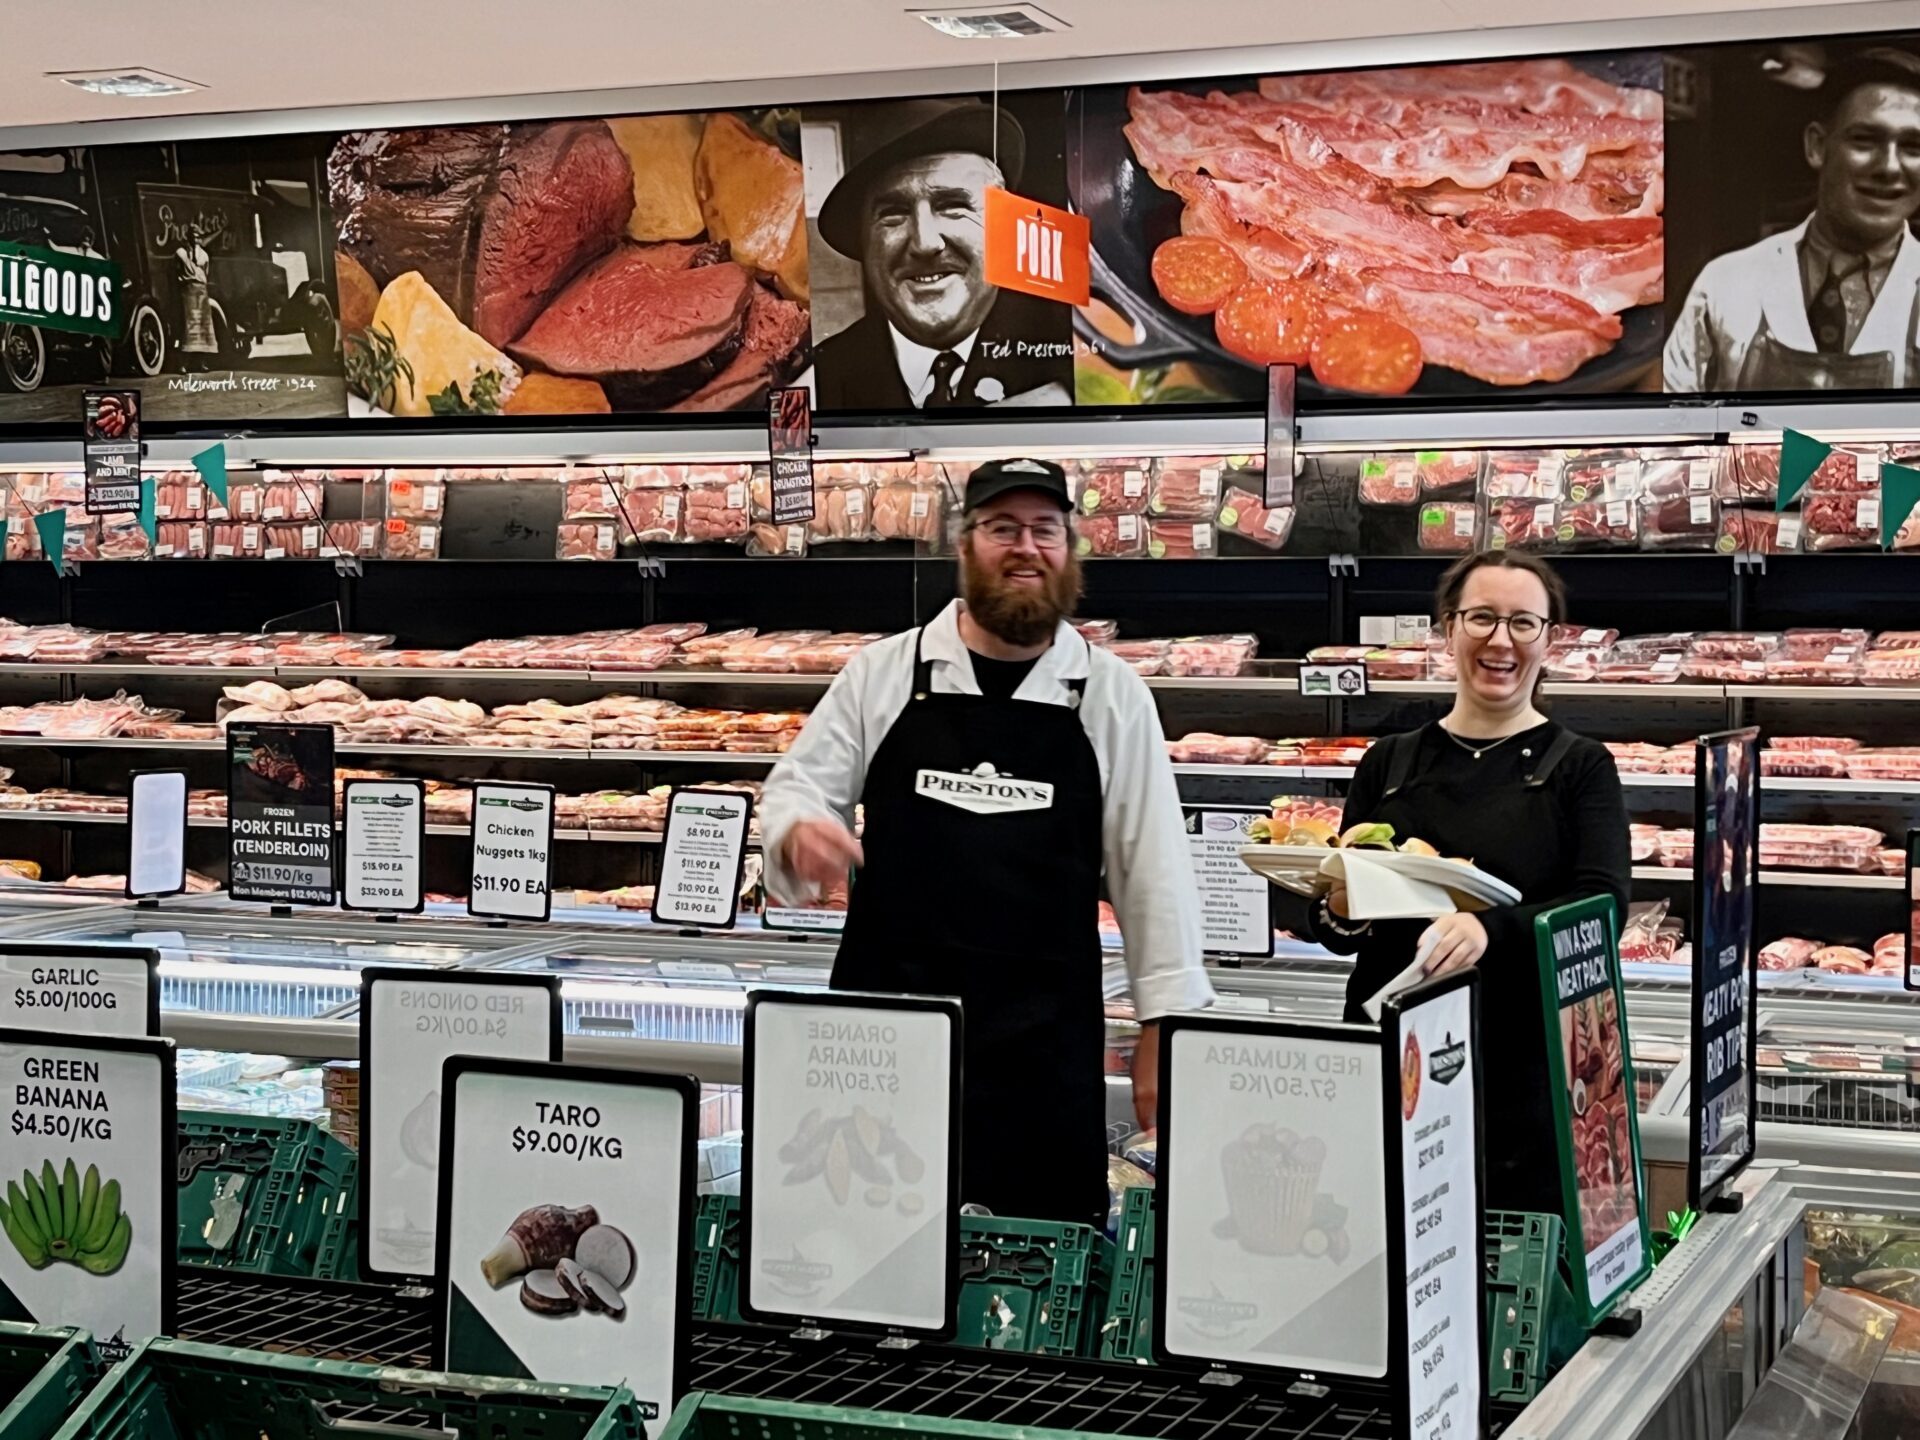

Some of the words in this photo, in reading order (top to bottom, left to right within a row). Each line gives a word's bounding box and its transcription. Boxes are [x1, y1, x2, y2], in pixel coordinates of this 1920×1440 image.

[1016, 218, 1064, 283] PORK
[981, 339, 1012, 359] Ted
[1017, 340, 1074, 358] Preston
[168, 371, 238, 392] Molesworth
[241, 376, 281, 391] Street
[286, 377, 317, 391] 1924
[96, 467, 112, 477] AND
[777, 460, 808, 475] CHICKEN
[922, 774, 1048, 802] PRESTON'S
[263, 807, 295, 817] FROZEN
[232, 818, 271, 835] PORK
[274, 821, 331, 838] FILLETS
[487, 823, 535, 838] Chicken
[713, 829, 724, 838] EA
[233, 839, 330, 861] (TENDERLOIN)
[476, 844, 525, 860] Nuggets
[528, 848, 547, 863] 1kg
[392, 863, 403, 872] EA
[681, 858, 707, 870] $11.90
[709, 861, 721, 870] EA
[253, 866, 313, 885] $11.90/kg
[473, 873, 521, 892] $11.90
[525, 879, 546, 896] EA
[233, 886, 250, 895] Non
[251, 887, 290, 898] Members
[392, 888, 404, 897] EA
[677, 882, 706, 893] $10.90
[708, 885, 720, 894] EA
[704, 904, 716, 913] EA
[1552, 928, 1574, 960] WIN
[1573, 925, 1582, 954] A
[32, 968, 100, 986] GARLIC
[1557, 963, 1583, 1000] MEAT
[1582, 954, 1609, 990] PACK
[14, 988, 117, 1012] $5.00/100G
[1707, 1036, 1724, 1083] RIB
[24, 1057, 99, 1083] GREEN
[16, 1085, 109, 1112] BANANA
[535, 1101, 601, 1128] TARO
[11, 1109, 112, 1143] $4.50/KG
[512, 1125, 623, 1161] $9.00/KG
